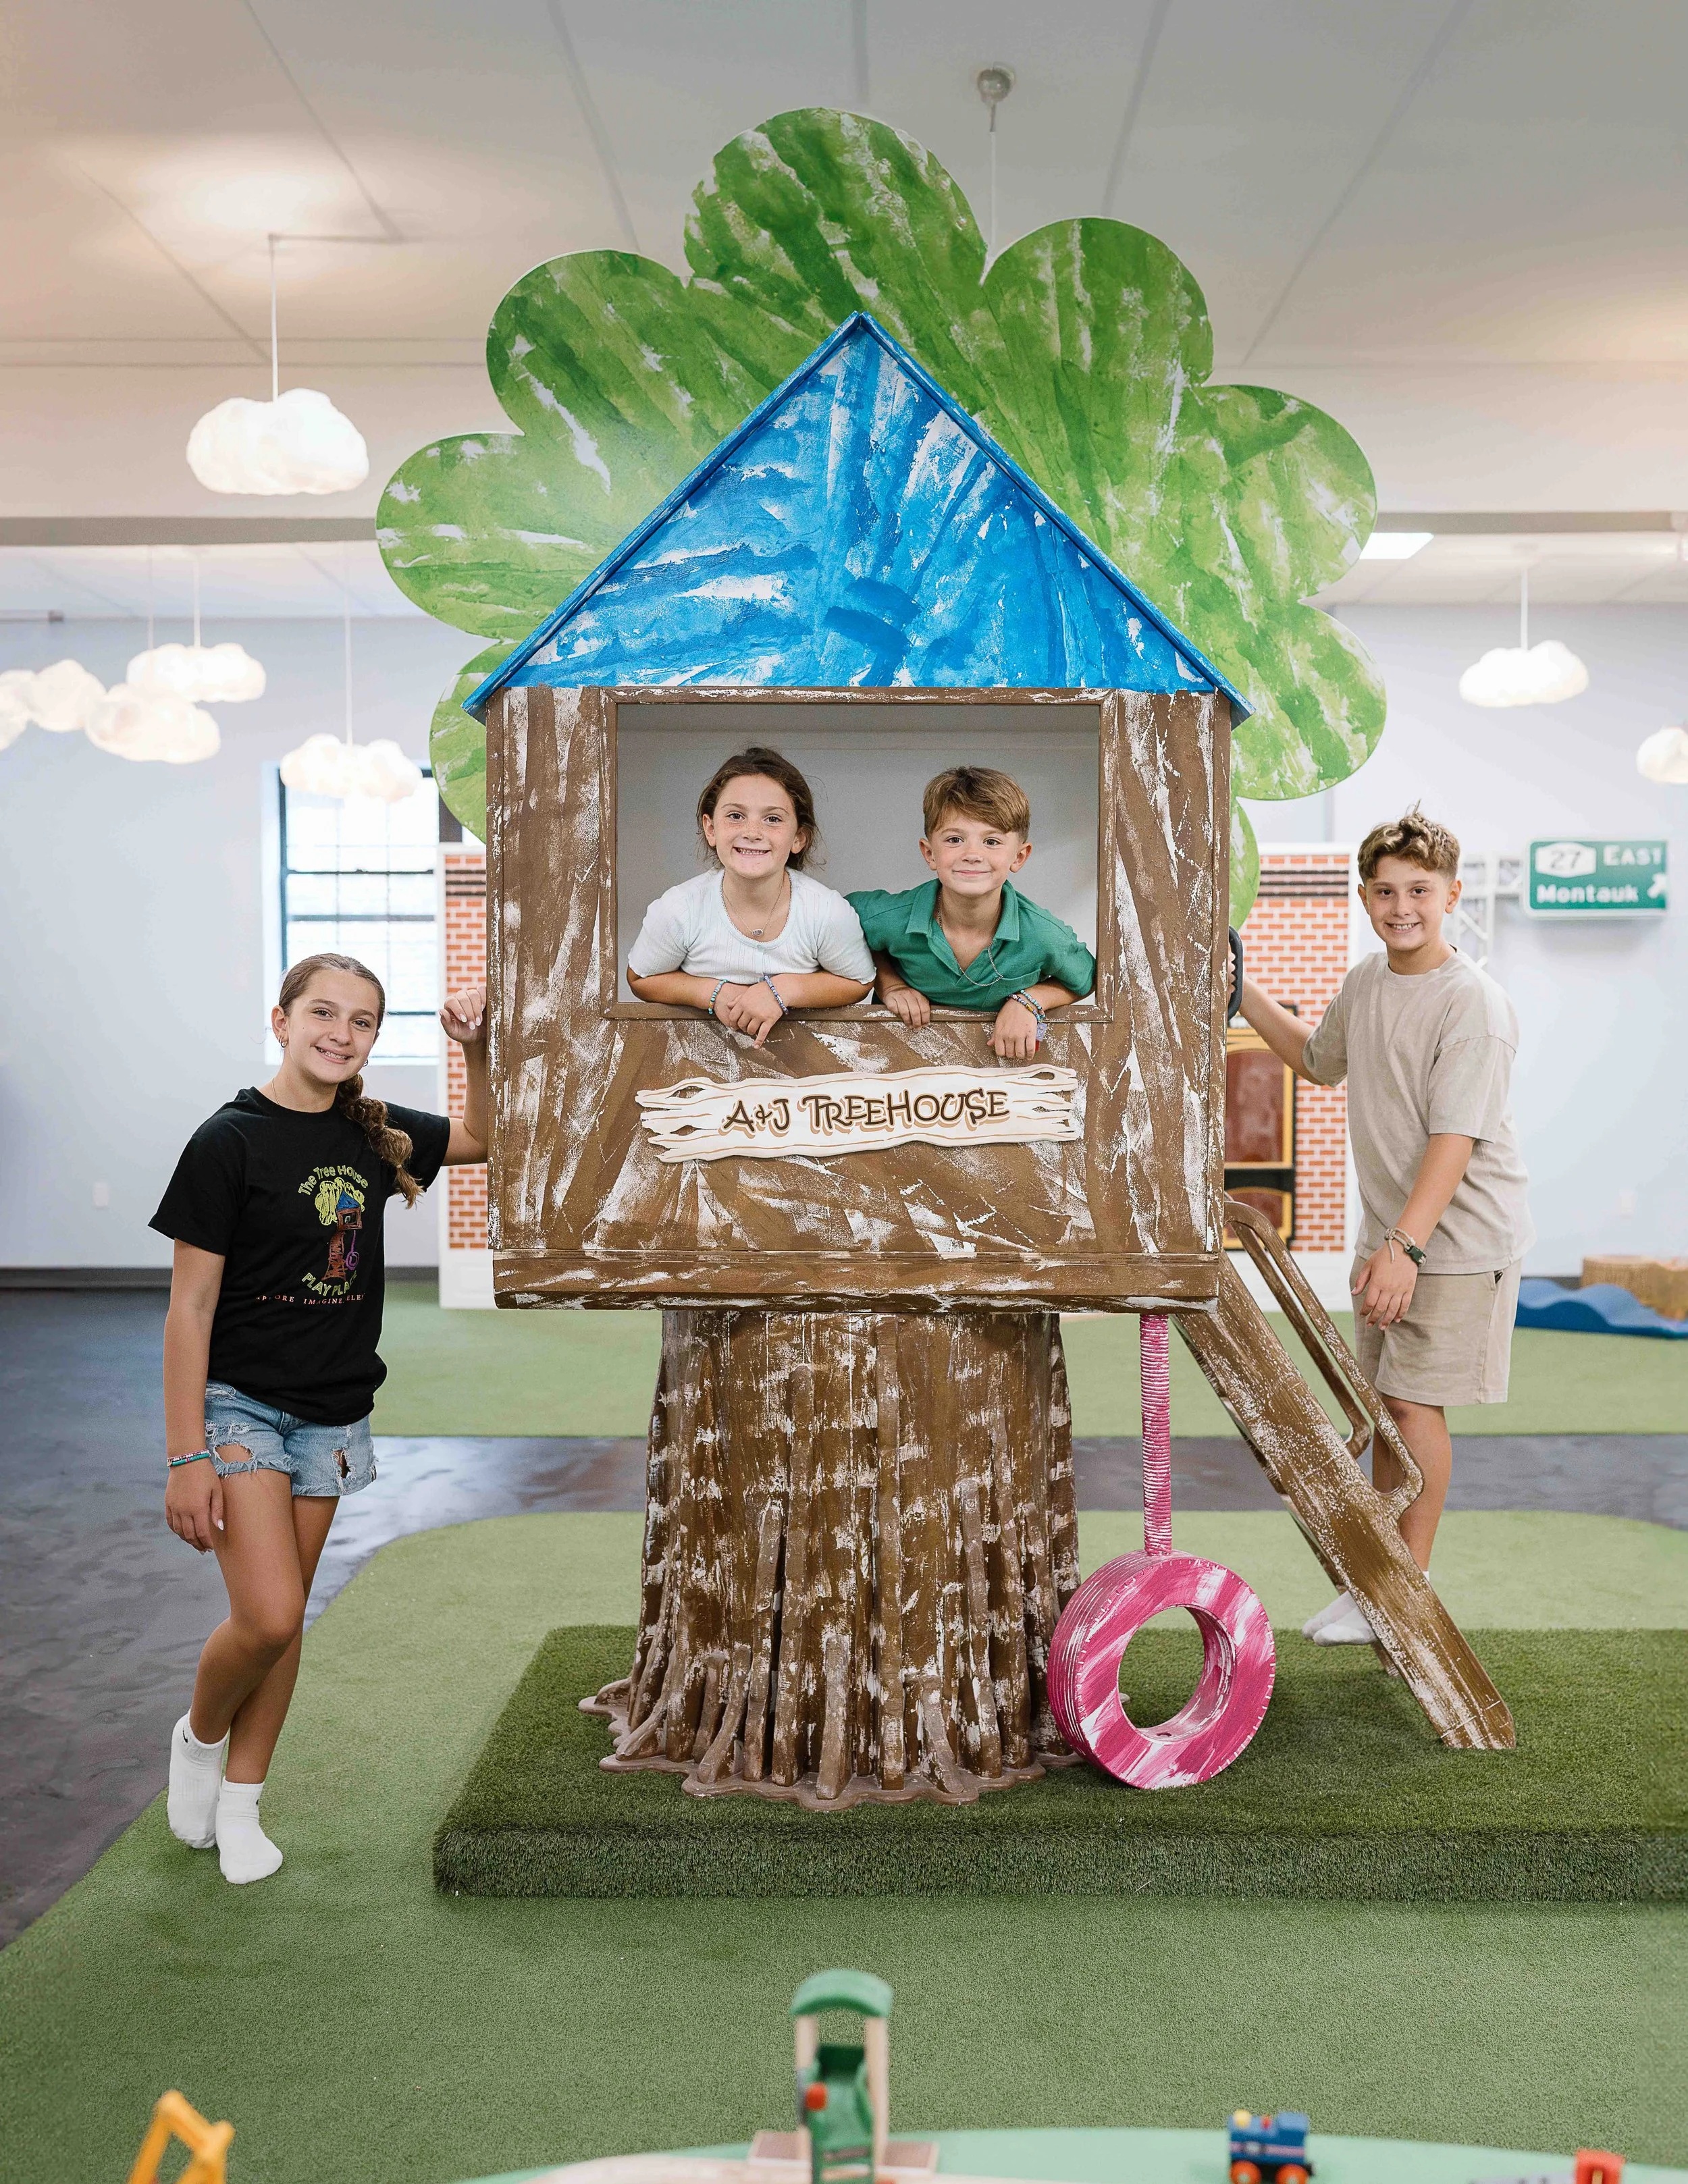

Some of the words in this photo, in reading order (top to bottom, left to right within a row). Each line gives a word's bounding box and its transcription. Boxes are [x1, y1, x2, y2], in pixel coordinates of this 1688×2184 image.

[1550, 849, 1581, 870] 27
[1603, 845, 1662, 865] EAST
[1536, 883, 1639, 903] Montauk
[801, 1088, 1011, 1133] TREEHOUSE
[298, 1175, 317, 1195] The
[313, 1166, 336, 1179] Tree
[337, 1165, 369, 1188] House
[301, 1272, 332, 1296] PLAY
